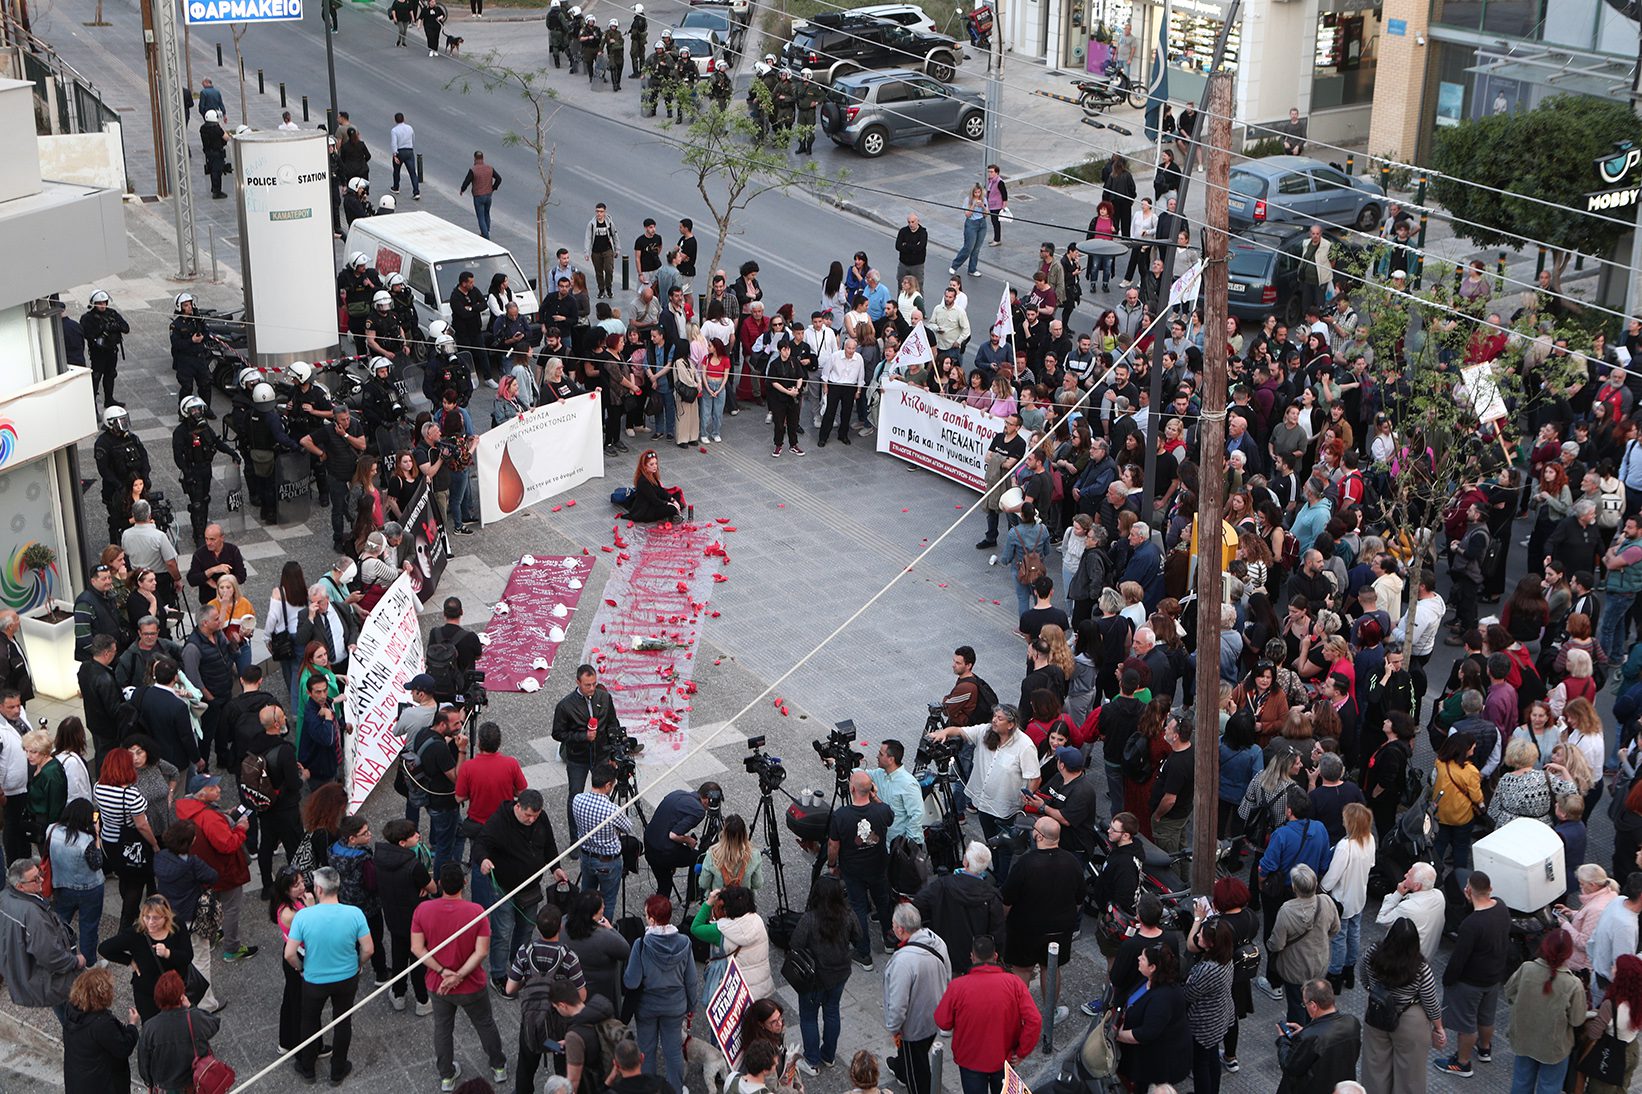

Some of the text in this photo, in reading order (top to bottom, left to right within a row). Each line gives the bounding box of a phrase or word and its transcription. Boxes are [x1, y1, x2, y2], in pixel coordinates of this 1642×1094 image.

[190, 0, 300, 19] ΦΑΡΜΑΚΕΙΟ
[247, 171, 326, 186] POLICE STATION
[900, 391, 939, 419] Χτίζουμε
[942, 411, 973, 432] ασπίδα
[892, 426, 906, 438] στη
[907, 428, 920, 443] βία
[922, 437, 934, 449] και
[936, 442, 945, 454] τη
[945, 446, 981, 469] γυναικεία
[941, 427, 984, 456] ΑΠΕΝΑΝΤΙ
[352, 633, 381, 669] ΑΛΛΗ
[381, 691, 398, 711] ΤΟΥ
[355, 758, 387, 792] ΝΕΑ
[712, 970, 741, 1027] ΚΑΤΑΠΙΕΣΗ
[719, 983, 749, 1045] ΠΑΛΕΥΟΥΜΕ
